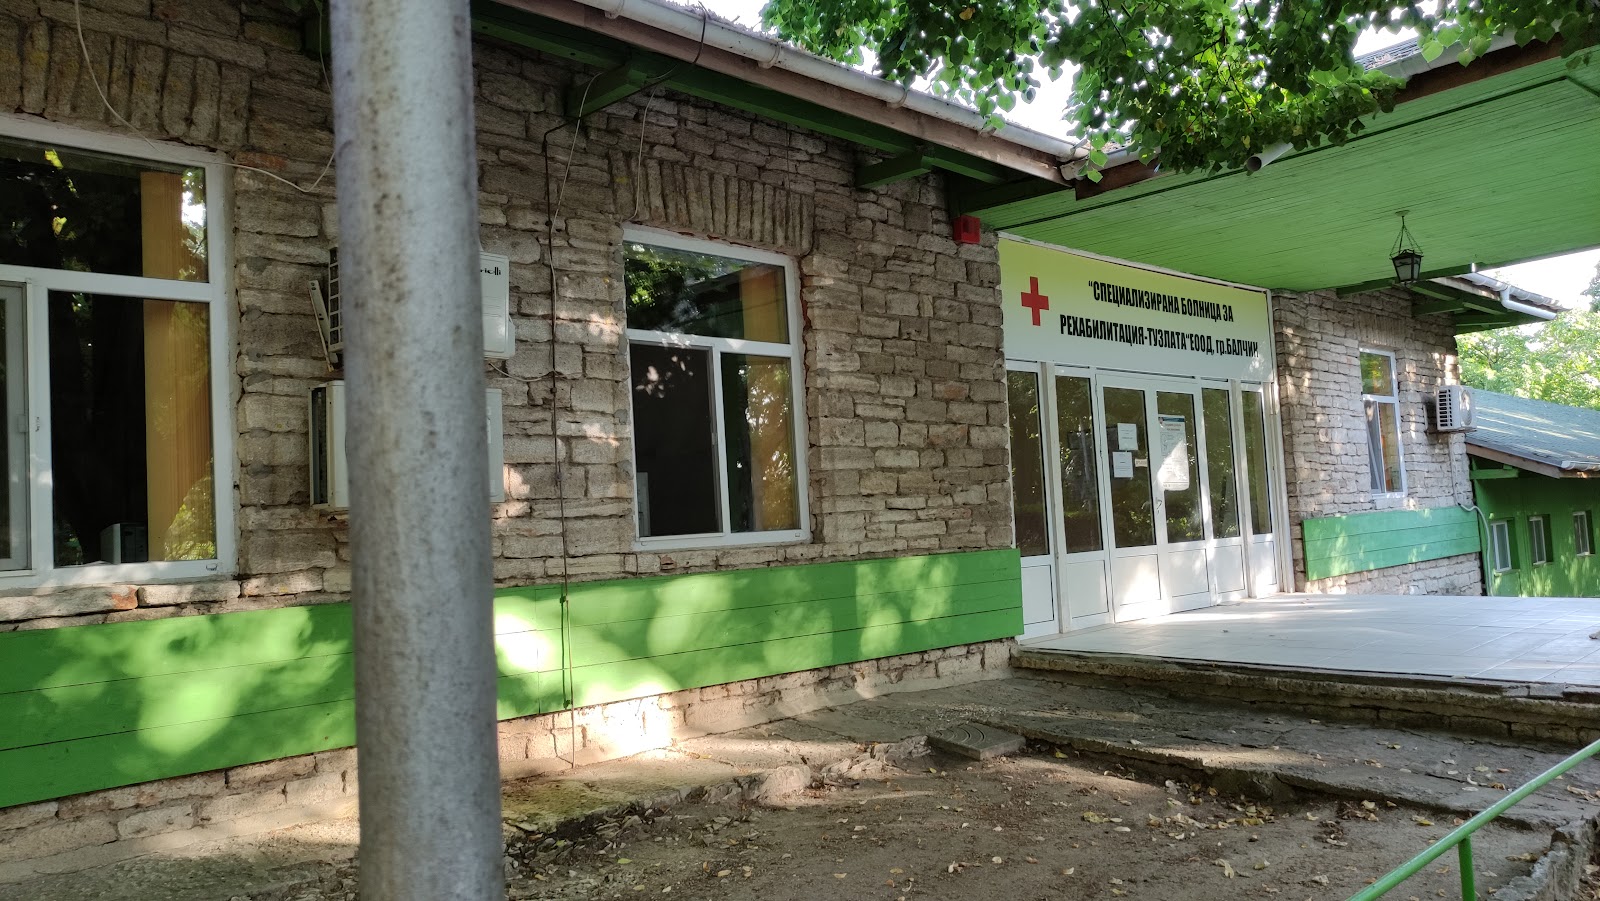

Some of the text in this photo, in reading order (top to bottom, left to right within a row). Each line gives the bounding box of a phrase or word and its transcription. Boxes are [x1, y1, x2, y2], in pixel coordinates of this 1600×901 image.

[1088, 280, 1234, 323] “СПЕЦИАЛИЗИРАНА БОЛНИЦА ЗА
